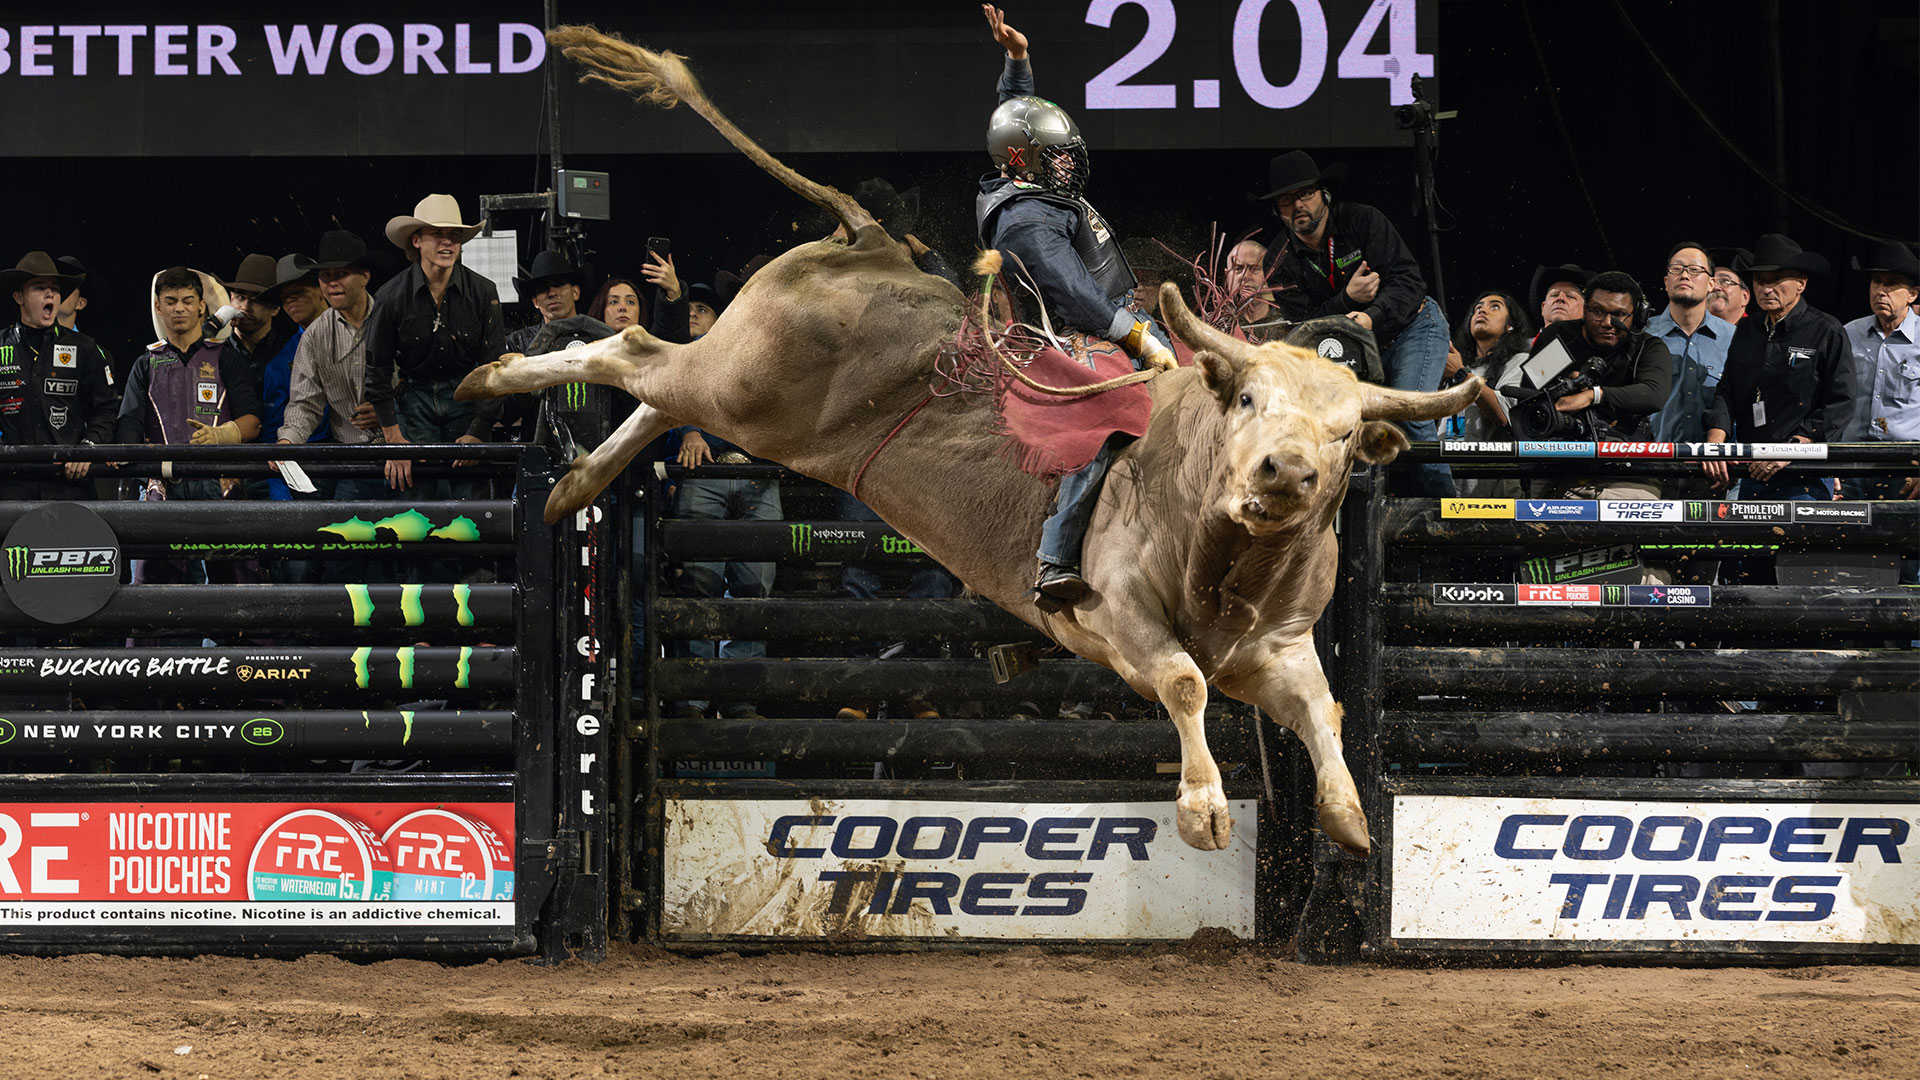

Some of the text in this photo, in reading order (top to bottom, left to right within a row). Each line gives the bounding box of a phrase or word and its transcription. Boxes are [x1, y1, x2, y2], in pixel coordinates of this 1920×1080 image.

[0, 24, 546, 75] ETTER WORLD
[1084, 0, 1434, 109] 2.04
[47, 382, 76, 392] YETI
[1445, 442, 1512, 452] BOOT BARN
[1601, 443, 1671, 454] LUCAS OIL
[1685, 442, 1745, 457] YETI
[1607, 502, 1674, 510] COOPER
[1731, 503, 1785, 516] PENDLETON
[1616, 510, 1664, 519] TIRES
[1841, 510, 1866, 518] RACING
[813, 528, 866, 539] MONSTER
[32, 550, 114, 566] PBR
[31, 566, 71, 574] UNLEASH
[83, 565, 111, 573] BEAST
[1554, 566, 1594, 582] UNLEASH
[1606, 559, 1634, 571] BEAST
[1441, 586, 1504, 601] Kubota
[1529, 586, 1562, 600] FRE
[1667, 587, 1691, 596] MODO
[1667, 595, 1696, 604] CASINO
[40, 656, 230, 678] BUCKING BATTLE
[254, 668, 311, 680] ARIAT
[24, 725, 80, 738] NEW
[93, 725, 163, 738] YORK
[176, 725, 235, 738] CITY
[109, 813, 231, 850] NICOTINE
[767, 815, 1158, 861] COOPER
[1494, 814, 1911, 864] COOPER
[276, 831, 345, 872] FRE
[397, 831, 466, 872] FRE
[109, 856, 231, 894] POUCHES
[280, 878, 337, 897] WATERMELON
[414, 879, 446, 895] MINT
[818, 871, 1094, 917] TIRES
[1549, 873, 1843, 922] TIRES
[1, 908, 501, 923] This product contains nicotine. Nicotine is an addictive chemical.
